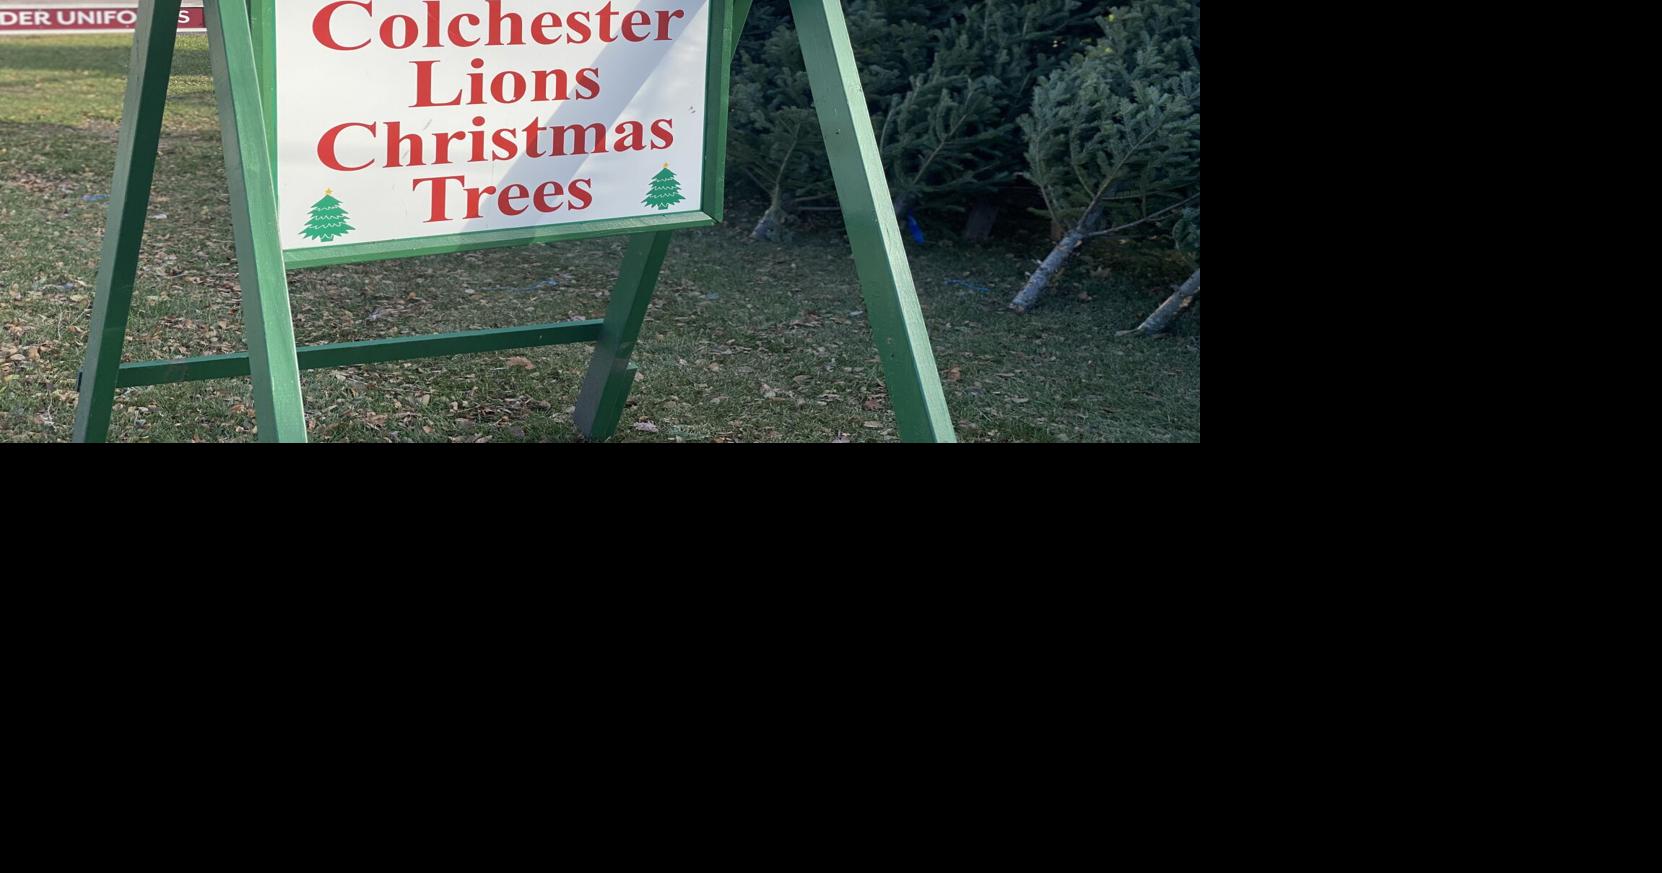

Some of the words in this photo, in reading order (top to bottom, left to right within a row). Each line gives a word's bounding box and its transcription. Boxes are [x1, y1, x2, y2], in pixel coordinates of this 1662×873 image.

[57, 10, 190, 26] UNIFOS
[311, 0, 684, 51] Colchester
[409, 58, 600, 108] Lions
[316, 116, 673, 172] Christmas
[412, 176, 593, 224] Trees
